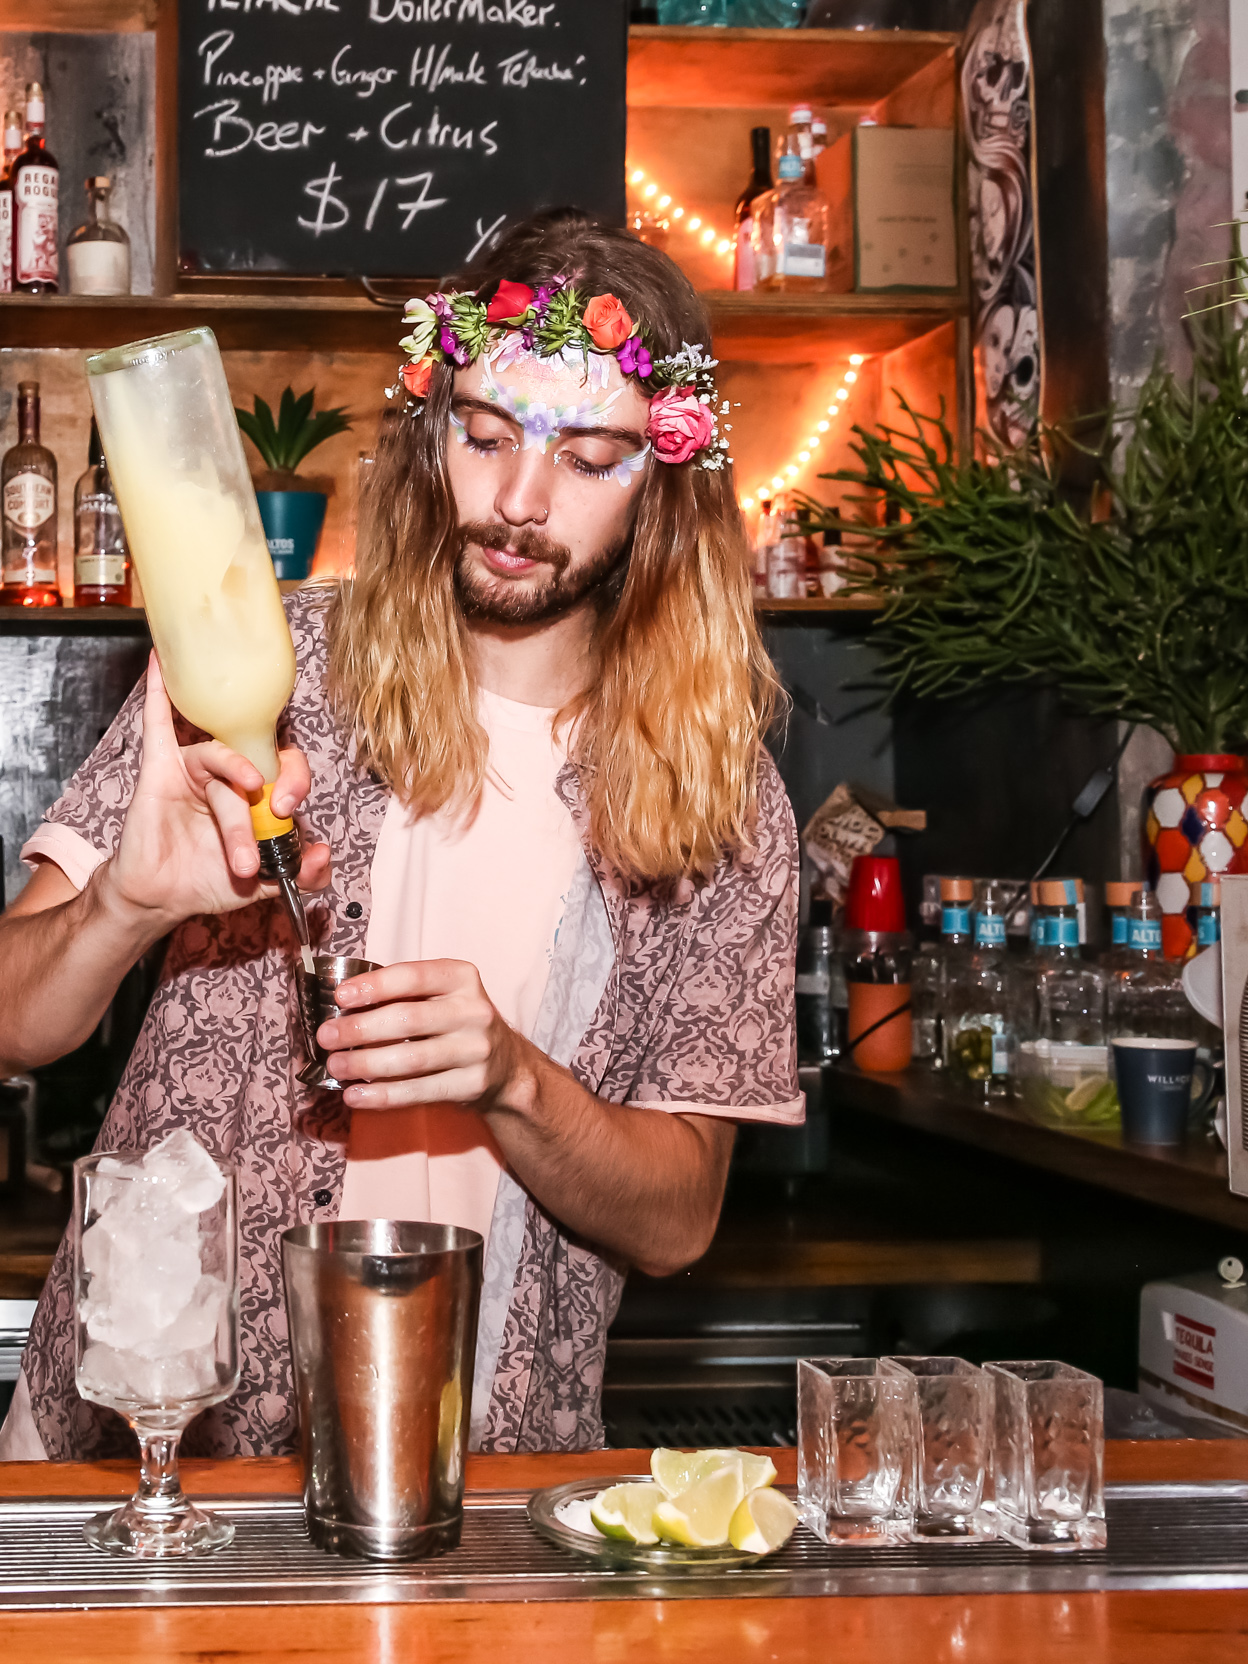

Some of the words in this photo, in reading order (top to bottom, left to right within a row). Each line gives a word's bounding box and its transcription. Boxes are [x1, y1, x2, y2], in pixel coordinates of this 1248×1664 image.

[198, 29, 303, 102] Pineapple
[330, 44, 398, 97] Ginger
[193, 99, 325, 157] Beer
[348, 126, 368, 142] +
[380, 102, 498, 155] Citrus
[24, 173, 56, 185] REGA
[24, 186, 57, 199] ROGU
[297, 161, 448, 236] $17
